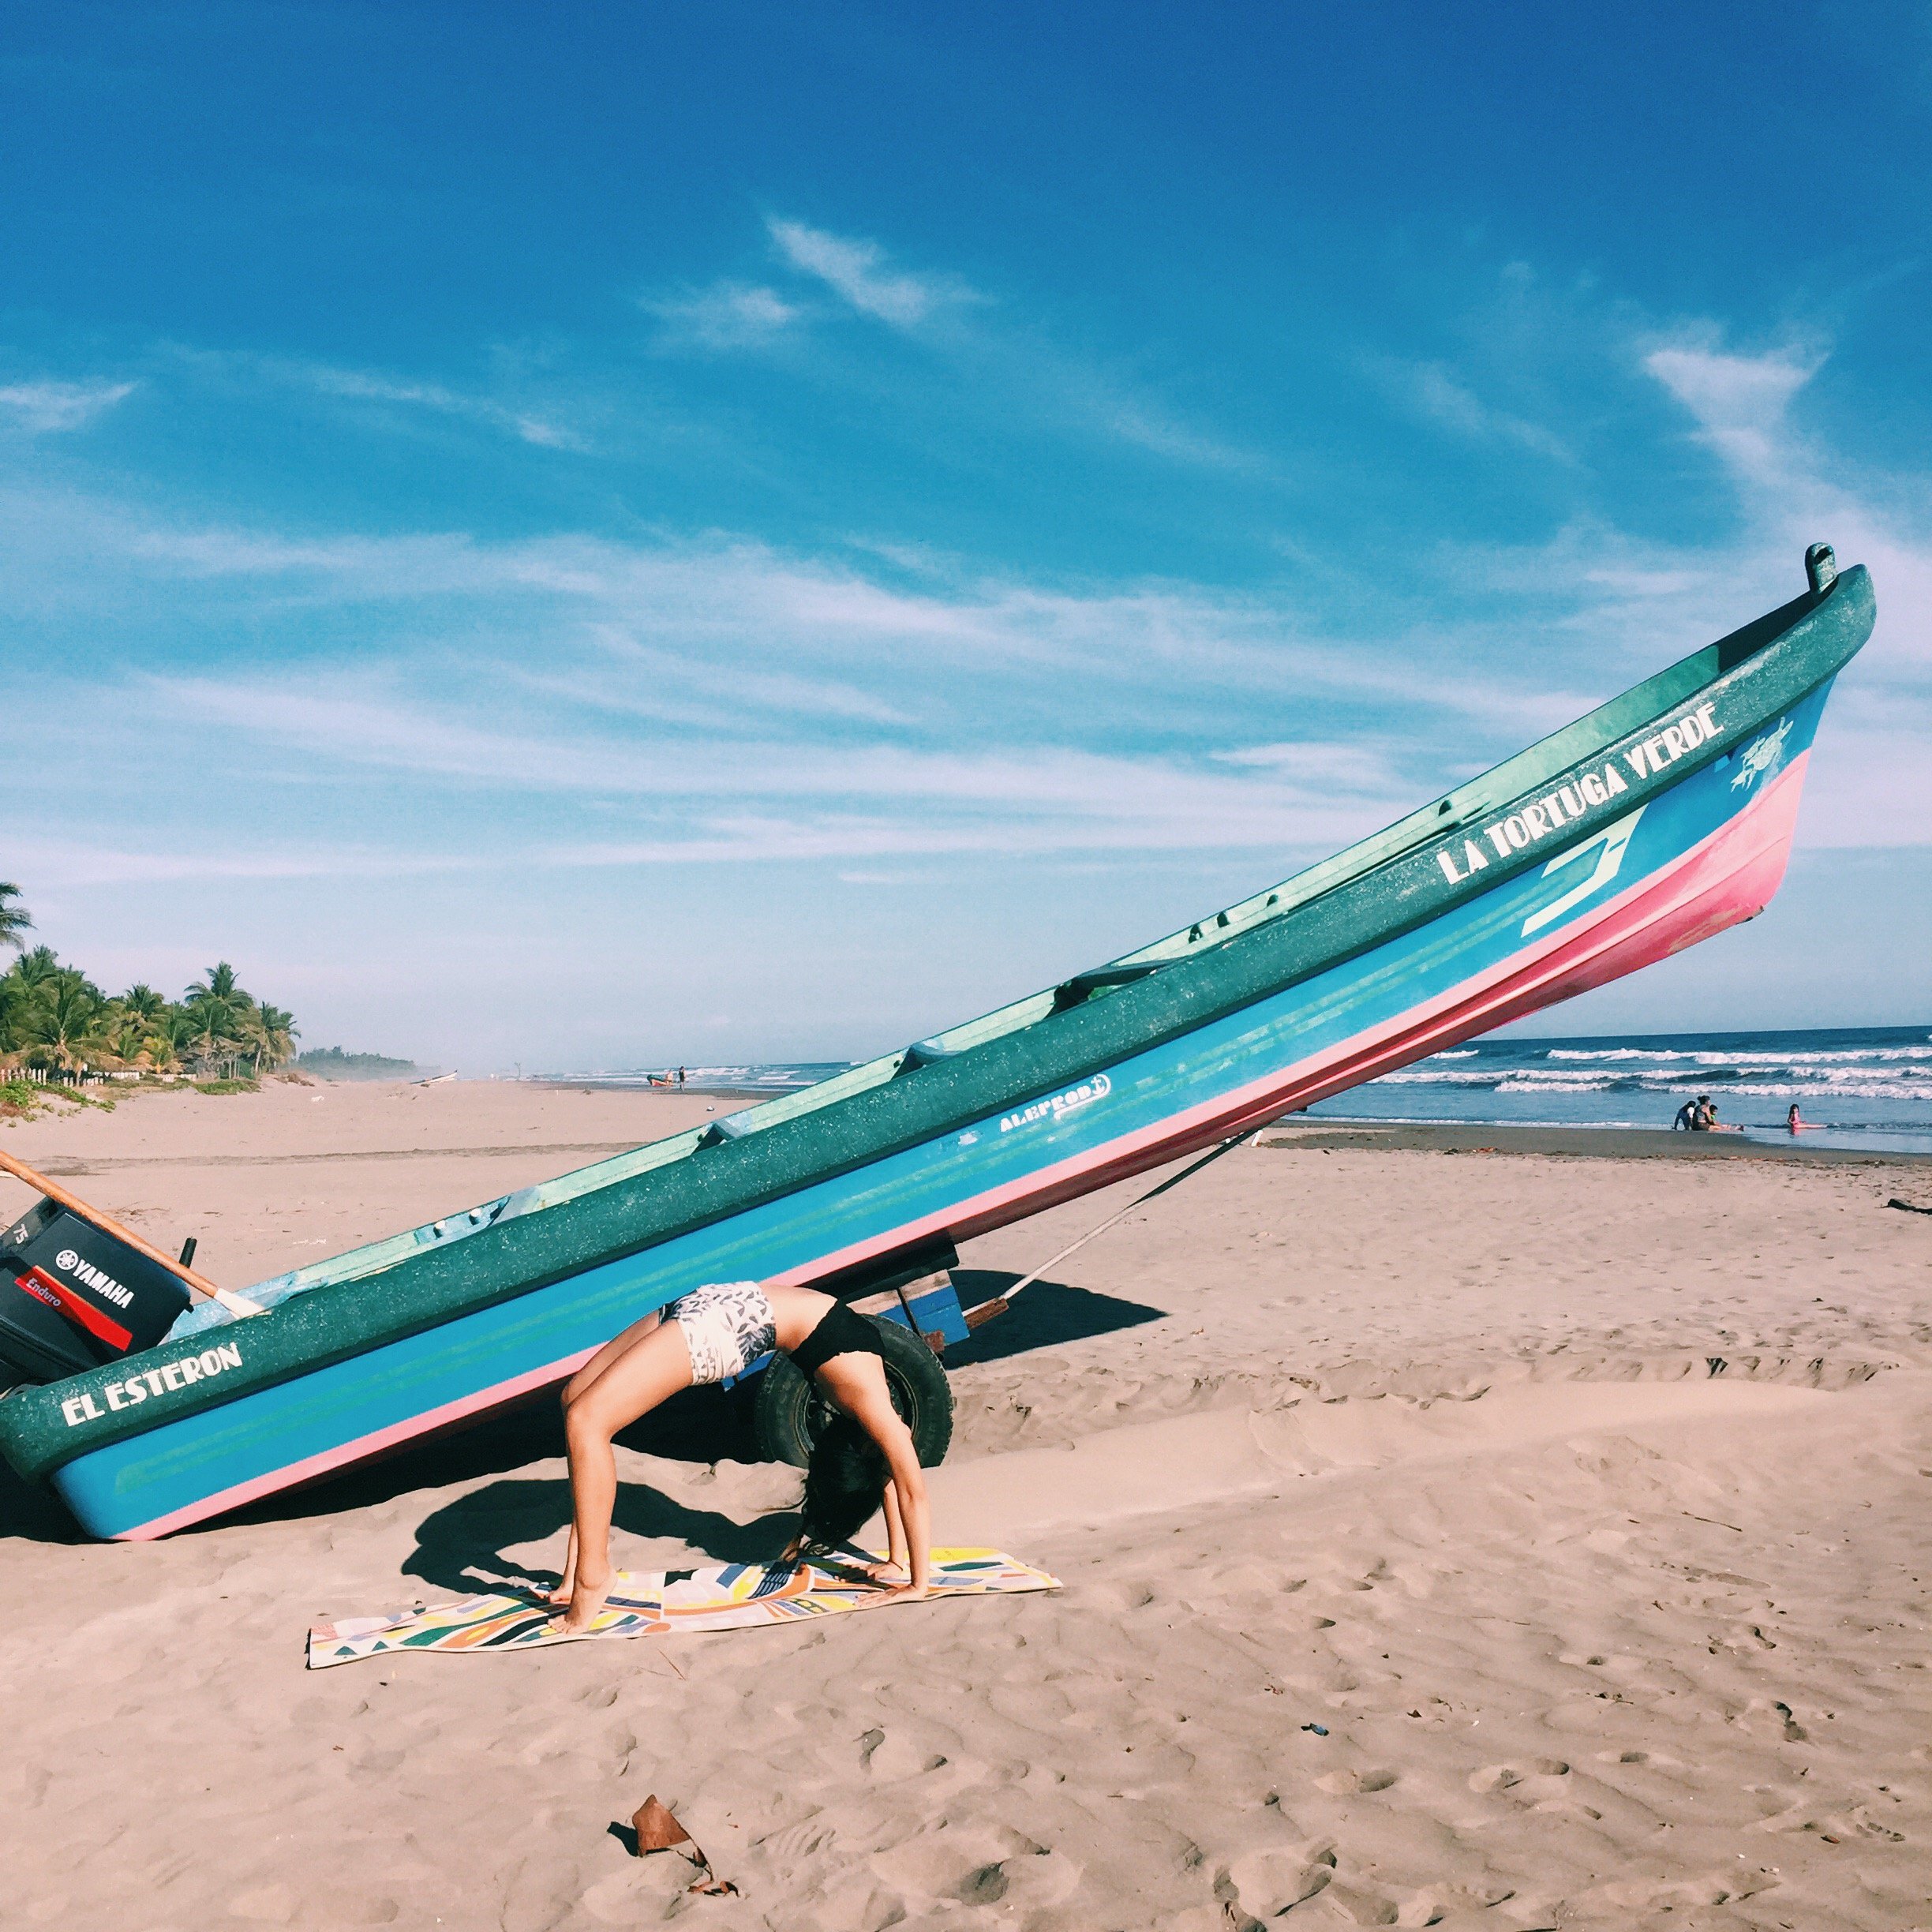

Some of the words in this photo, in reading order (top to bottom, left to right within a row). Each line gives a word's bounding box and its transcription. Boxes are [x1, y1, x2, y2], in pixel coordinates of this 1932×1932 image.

[1436, 840, 1490, 885] LA
[1484, 763, 1628, 859] TORTUGA
[1623, 702, 1724, 779] VERDE
[13, 1223, 28, 1244] 75
[26, 1277, 62, 1307] Enduro
[73, 1259, 135, 1309] YAMAHA
[60, 1394, 105, 1427] EL
[104, 1342, 243, 1412] ESTERON
